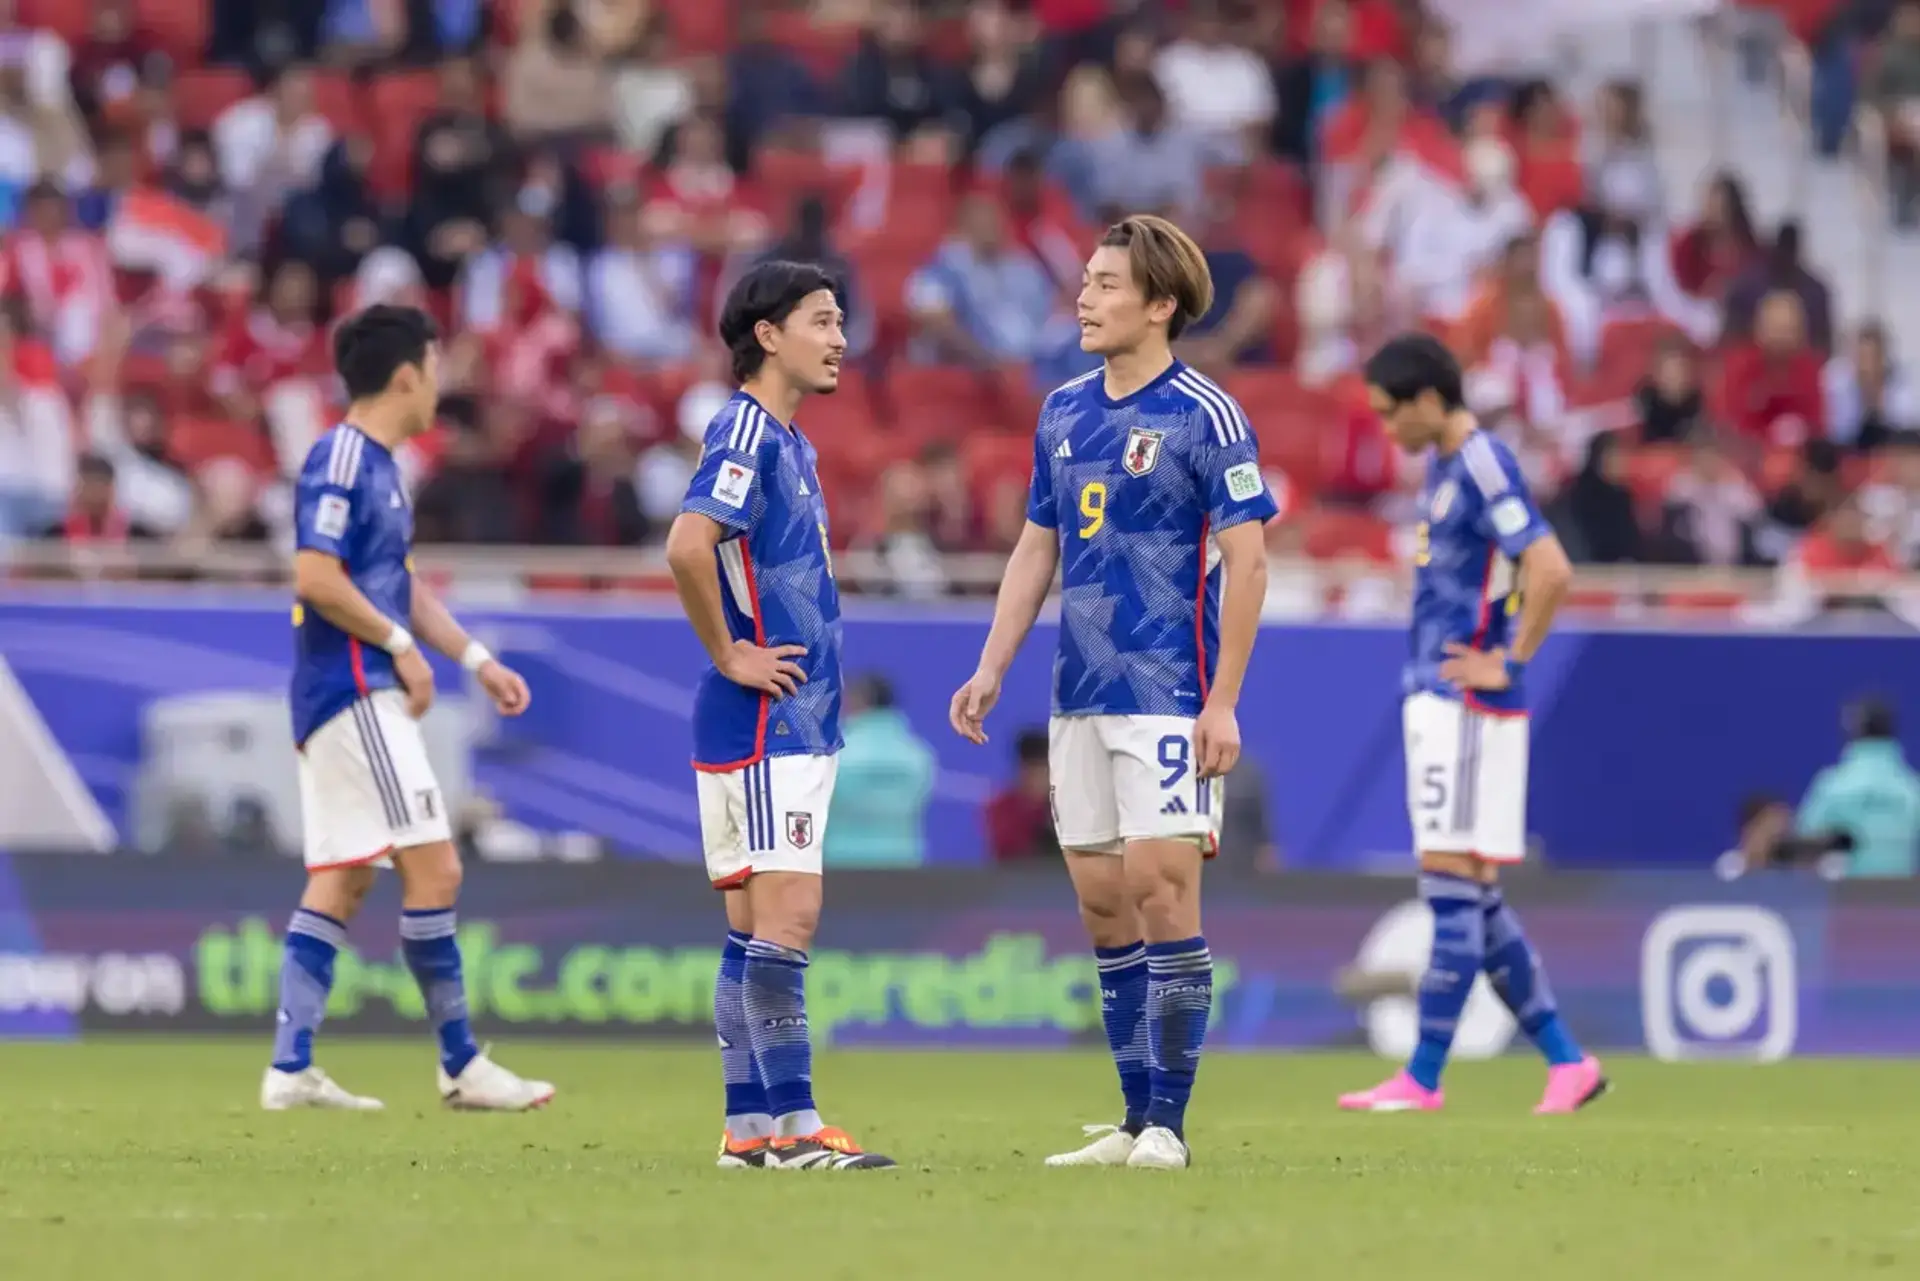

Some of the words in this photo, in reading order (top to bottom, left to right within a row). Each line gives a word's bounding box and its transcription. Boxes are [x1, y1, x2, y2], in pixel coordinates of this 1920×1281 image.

[1078, 482, 1108, 540] 9
[1157, 734, 1190, 790] 9
[1420, 766, 1448, 810] 5
